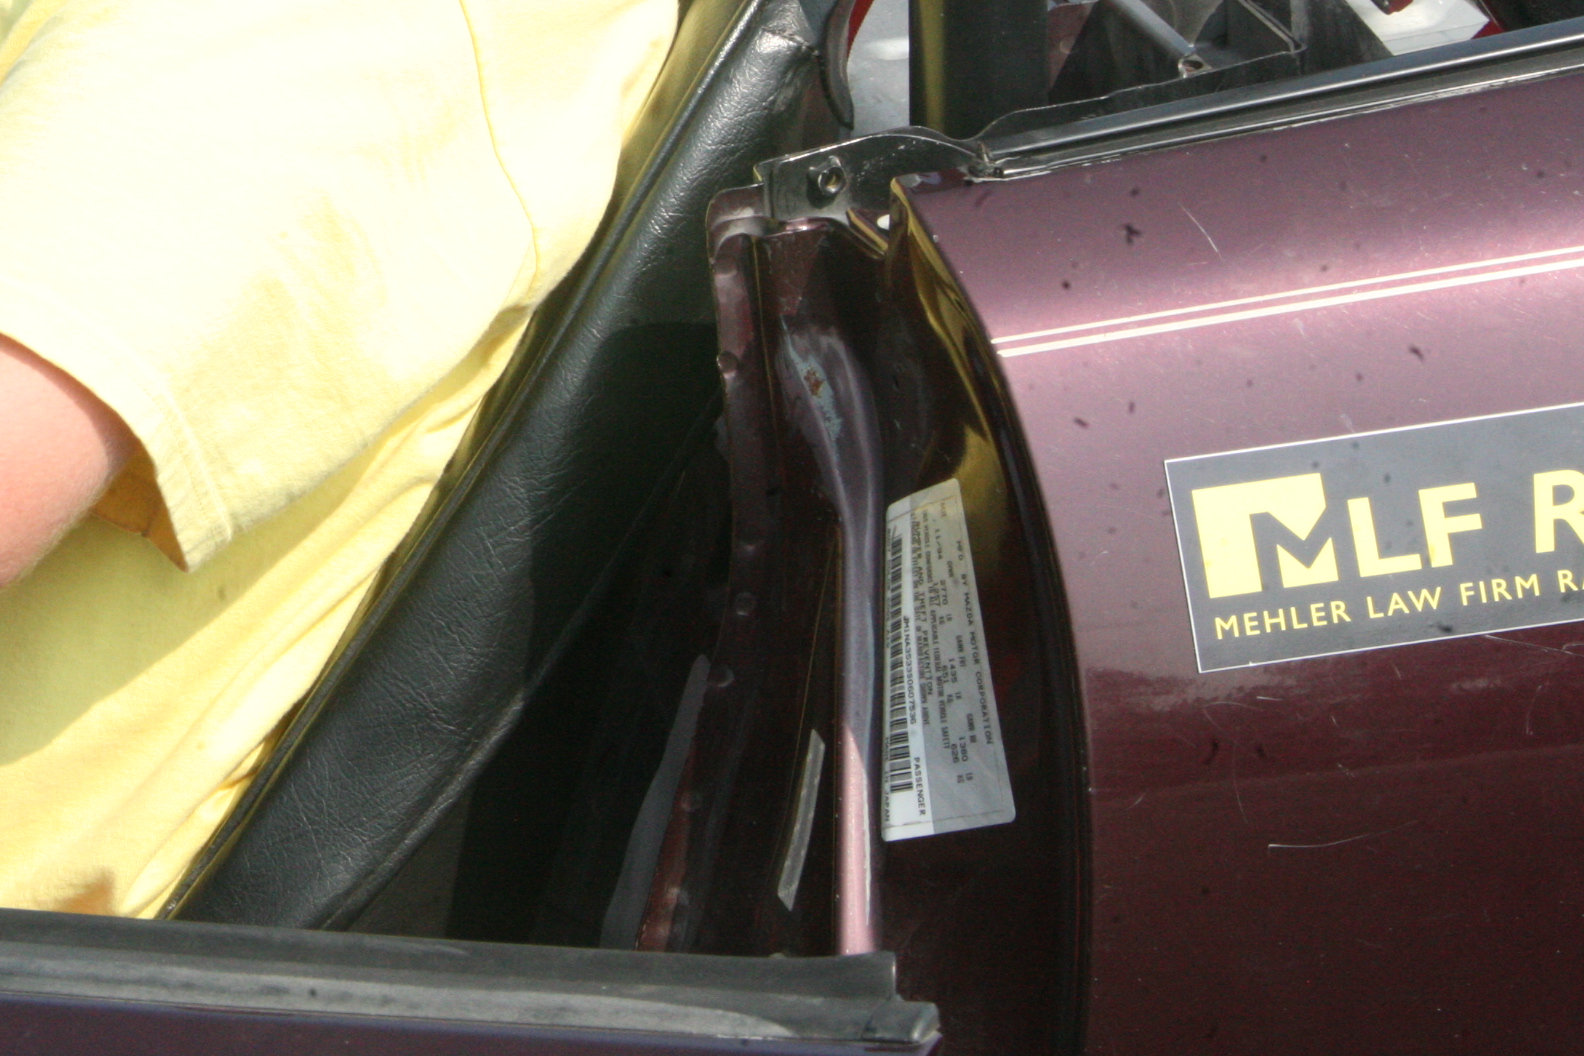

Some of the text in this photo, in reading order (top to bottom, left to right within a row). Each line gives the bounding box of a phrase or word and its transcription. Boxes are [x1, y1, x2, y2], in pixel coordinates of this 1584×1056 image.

[963, 590, 974, 626] MAZDA
[1214, 600, 1352, 640] MEHLER
[1366, 586, 1442, 619] LAW
[1459, 573, 1540, 606] FIRM
[921, 627, 934, 697] PREVENTION
[948, 656, 958, 684] 1435
[968, 630, 980, 666] MOTOR
[974, 670, 993, 747] CORPORATION
[912, 754, 925, 818] PASSENGER
